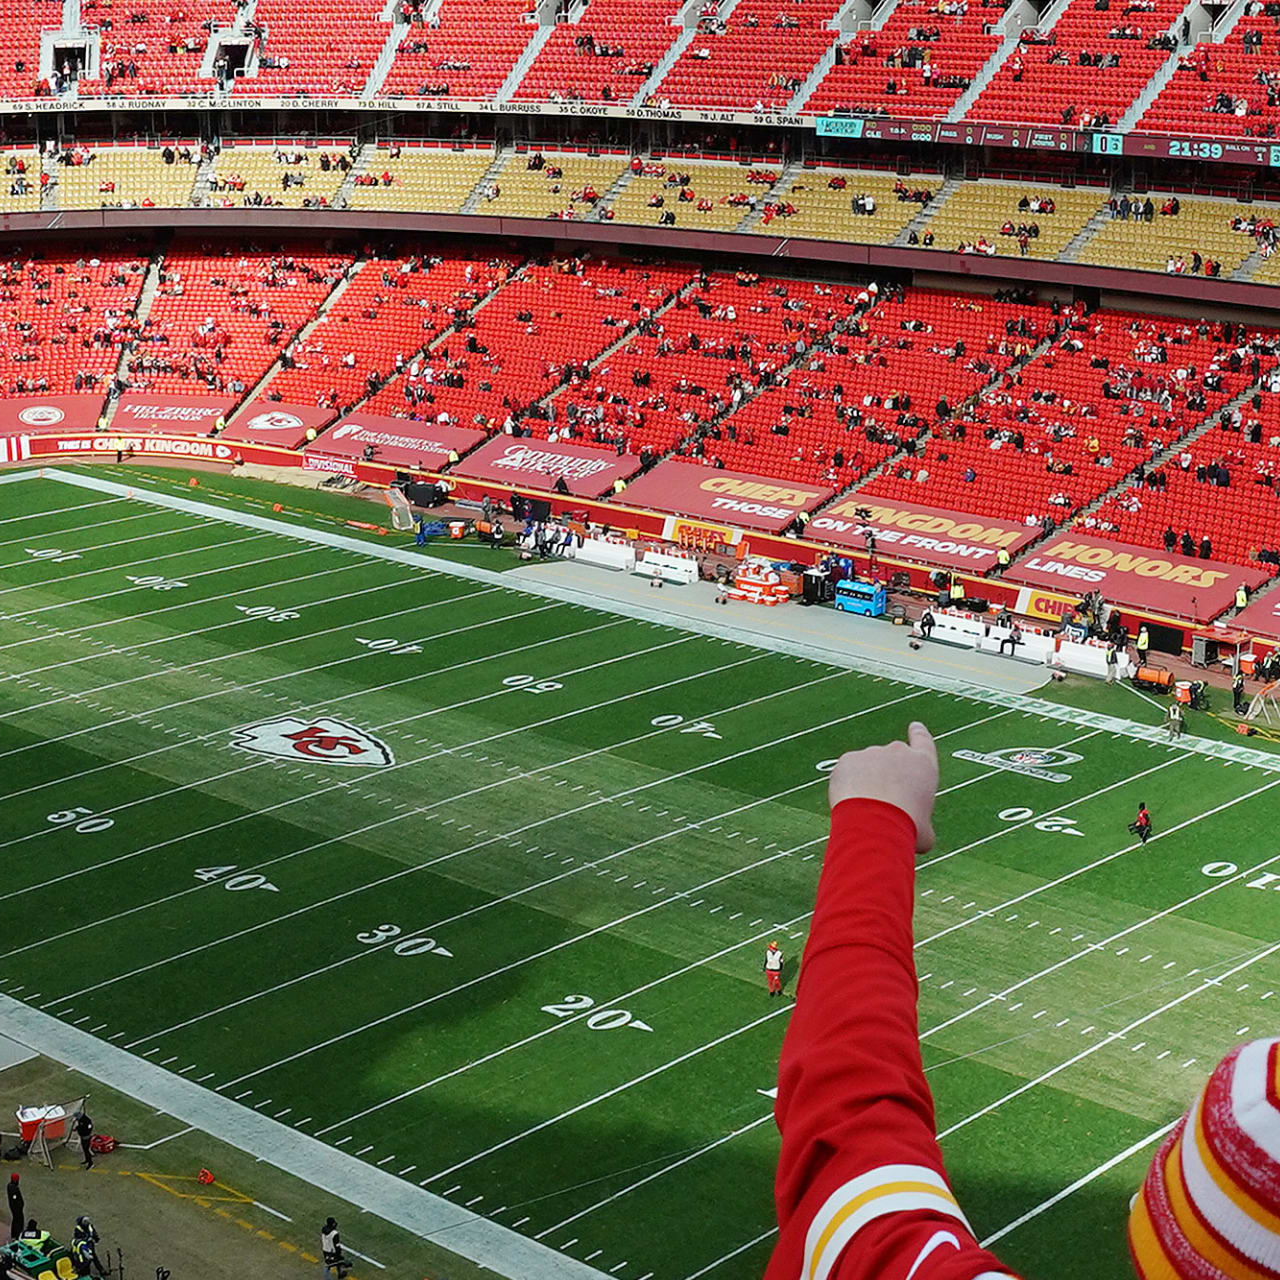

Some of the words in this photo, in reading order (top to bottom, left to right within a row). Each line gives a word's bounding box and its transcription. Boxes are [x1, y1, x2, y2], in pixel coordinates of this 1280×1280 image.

[301, 100, 338, 108] CHERRY
[500, 104, 541, 112] BURRUSS
[1168, 141, 1222, 159] 21:39
[57, 440, 79, 451] THIS
[80, 440, 92, 450] IS
[144, 439, 213, 457] KINGDOM
[504, 444, 615, 472] Community
[492, 452, 591, 480] America
[700, 477, 820, 508] CHIEFS
[711, 497, 796, 520] THOSE
[828, 500, 1022, 548] KINGDOM
[811, 517, 853, 533] ON
[854, 522, 907, 545] THE
[906, 533, 995, 560] FRONT
[1024, 558, 1108, 583] LINES
[1043, 540, 1231, 589] HONORS
[502, 674, 564, 695] 50
[48, 810, 115, 834] 50
[998, 806, 1078, 832] 20
[194, 864, 267, 891] 40
[356, 923, 437, 956] 30
[541, 994, 633, 1031] 20
